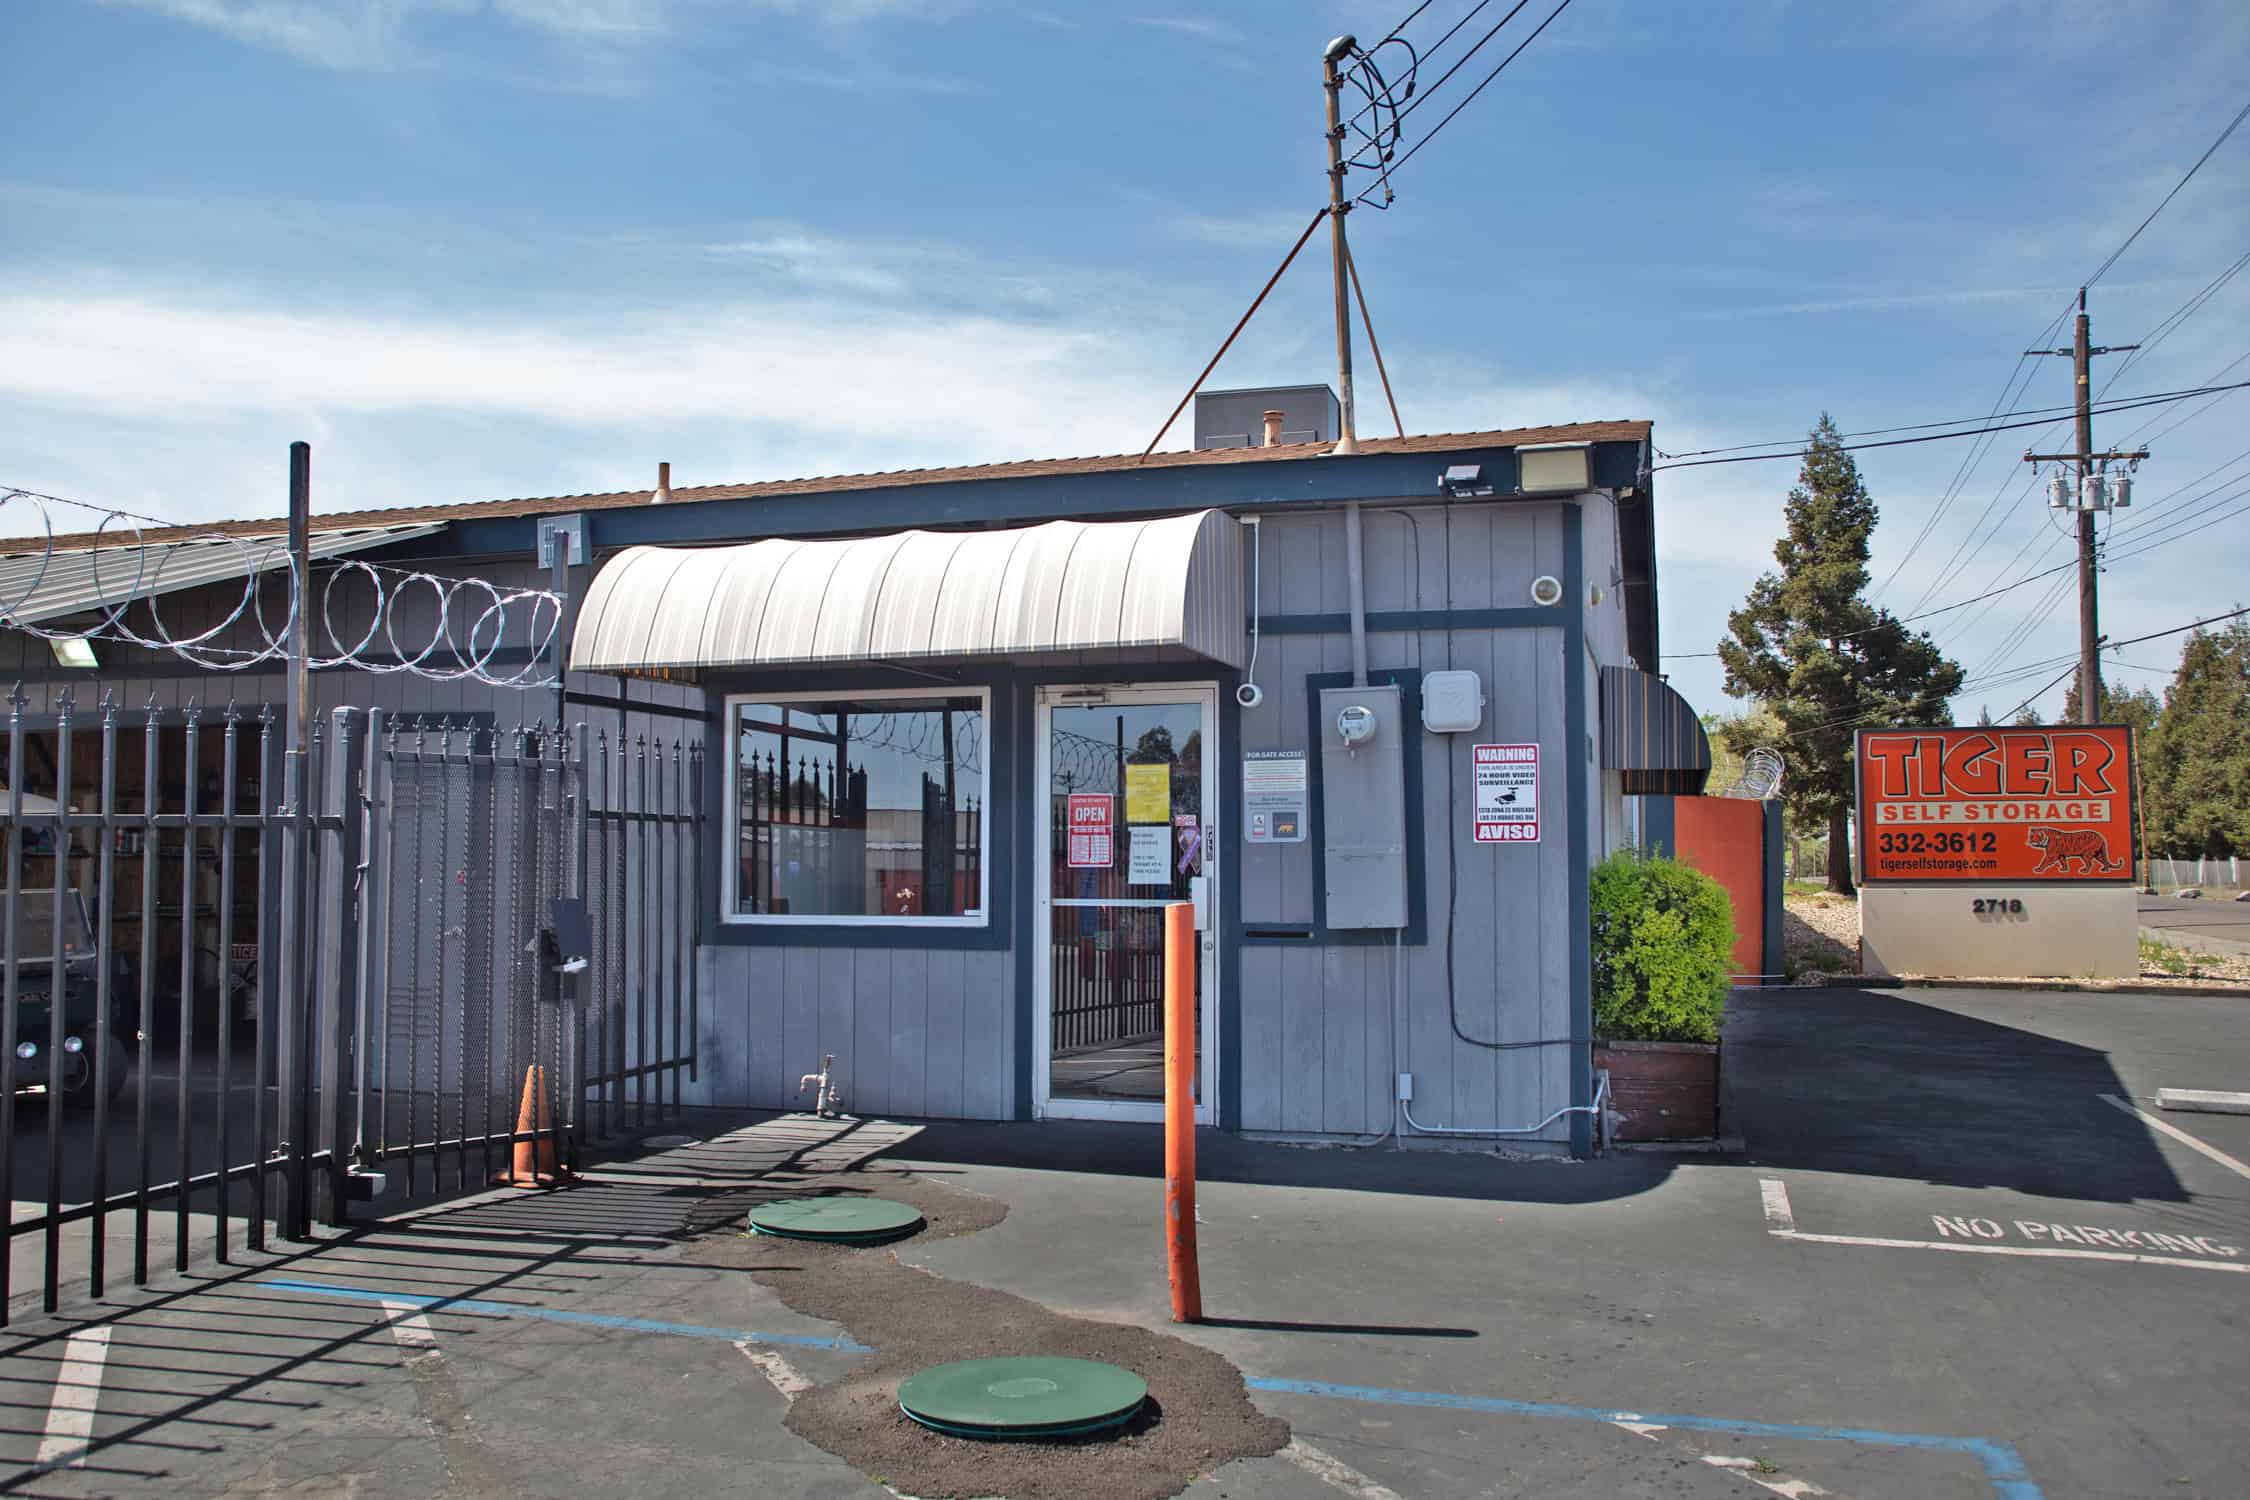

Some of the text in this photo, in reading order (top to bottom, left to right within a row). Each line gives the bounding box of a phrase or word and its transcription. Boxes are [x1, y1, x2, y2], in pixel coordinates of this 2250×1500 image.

[1477, 748, 1536, 761] WARNING
[1867, 732, 2117, 797] TIGER
[1075, 807, 1106, 822] OPEN
[1883, 803, 2104, 822] SELF STORAGE
[1479, 825, 1536, 839] AVISO
[1879, 832, 1997, 854] 332-3612
[1880, 857, 1997, 871] tigerselfstorage.com
[1972, 899, 2022, 914] 2718
[1931, 1215, 2240, 1257] NO PARKING
